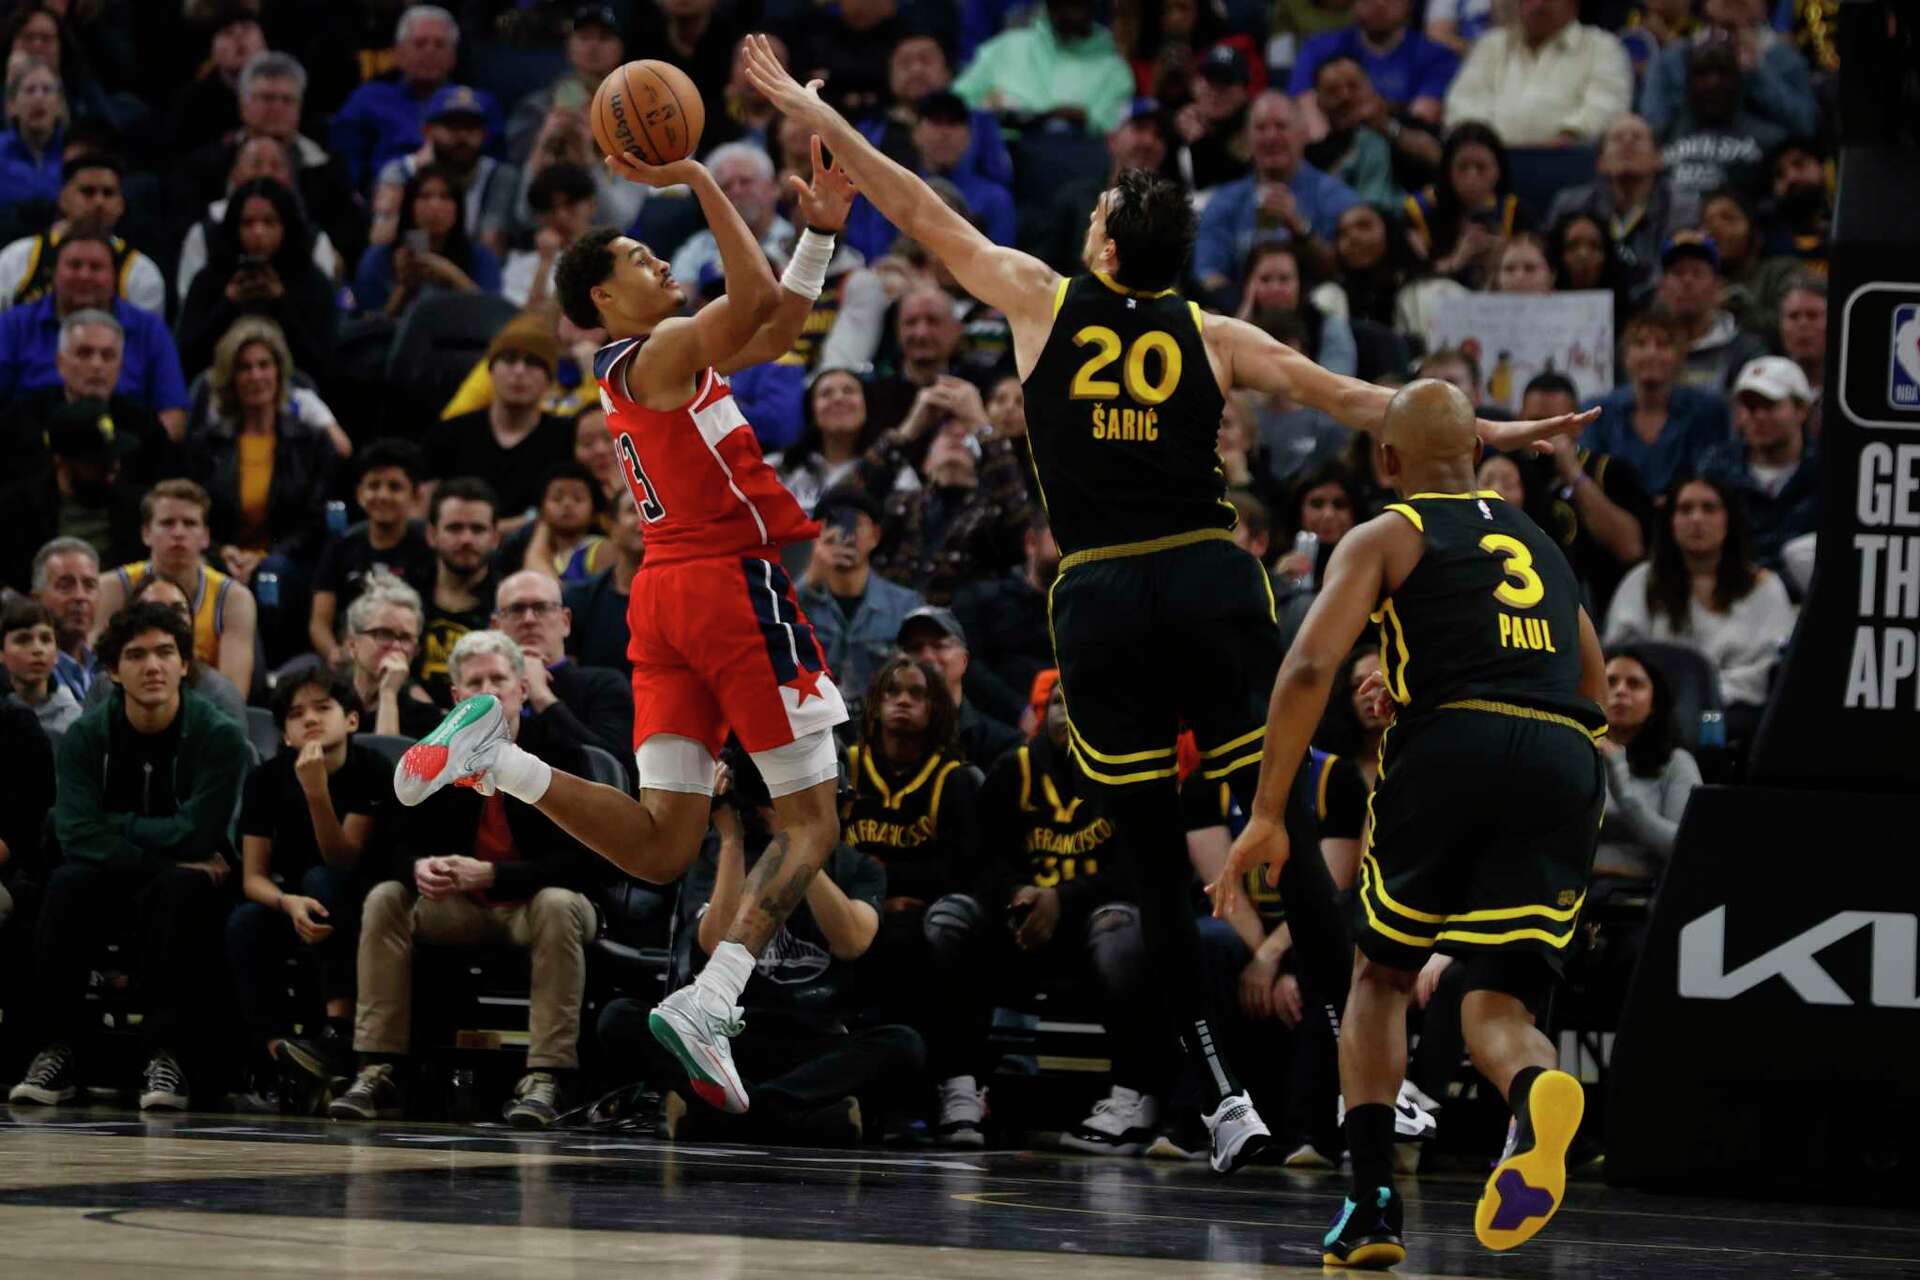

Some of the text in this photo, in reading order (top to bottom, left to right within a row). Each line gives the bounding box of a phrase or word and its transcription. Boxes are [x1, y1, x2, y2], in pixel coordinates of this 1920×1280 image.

[1069, 325, 1183, 405] 20
[1092, 402, 1160, 441] ŠARIĆ
[614, 431, 666, 524] 3
[1856, 441, 1920, 528] GE
[1477, 533, 1546, 609] 3
[1853, 533, 1920, 619] TH
[1498, 612, 1557, 654] PAUL
[1843, 625, 1920, 711] AP
[1677, 903, 1920, 1010] KI
